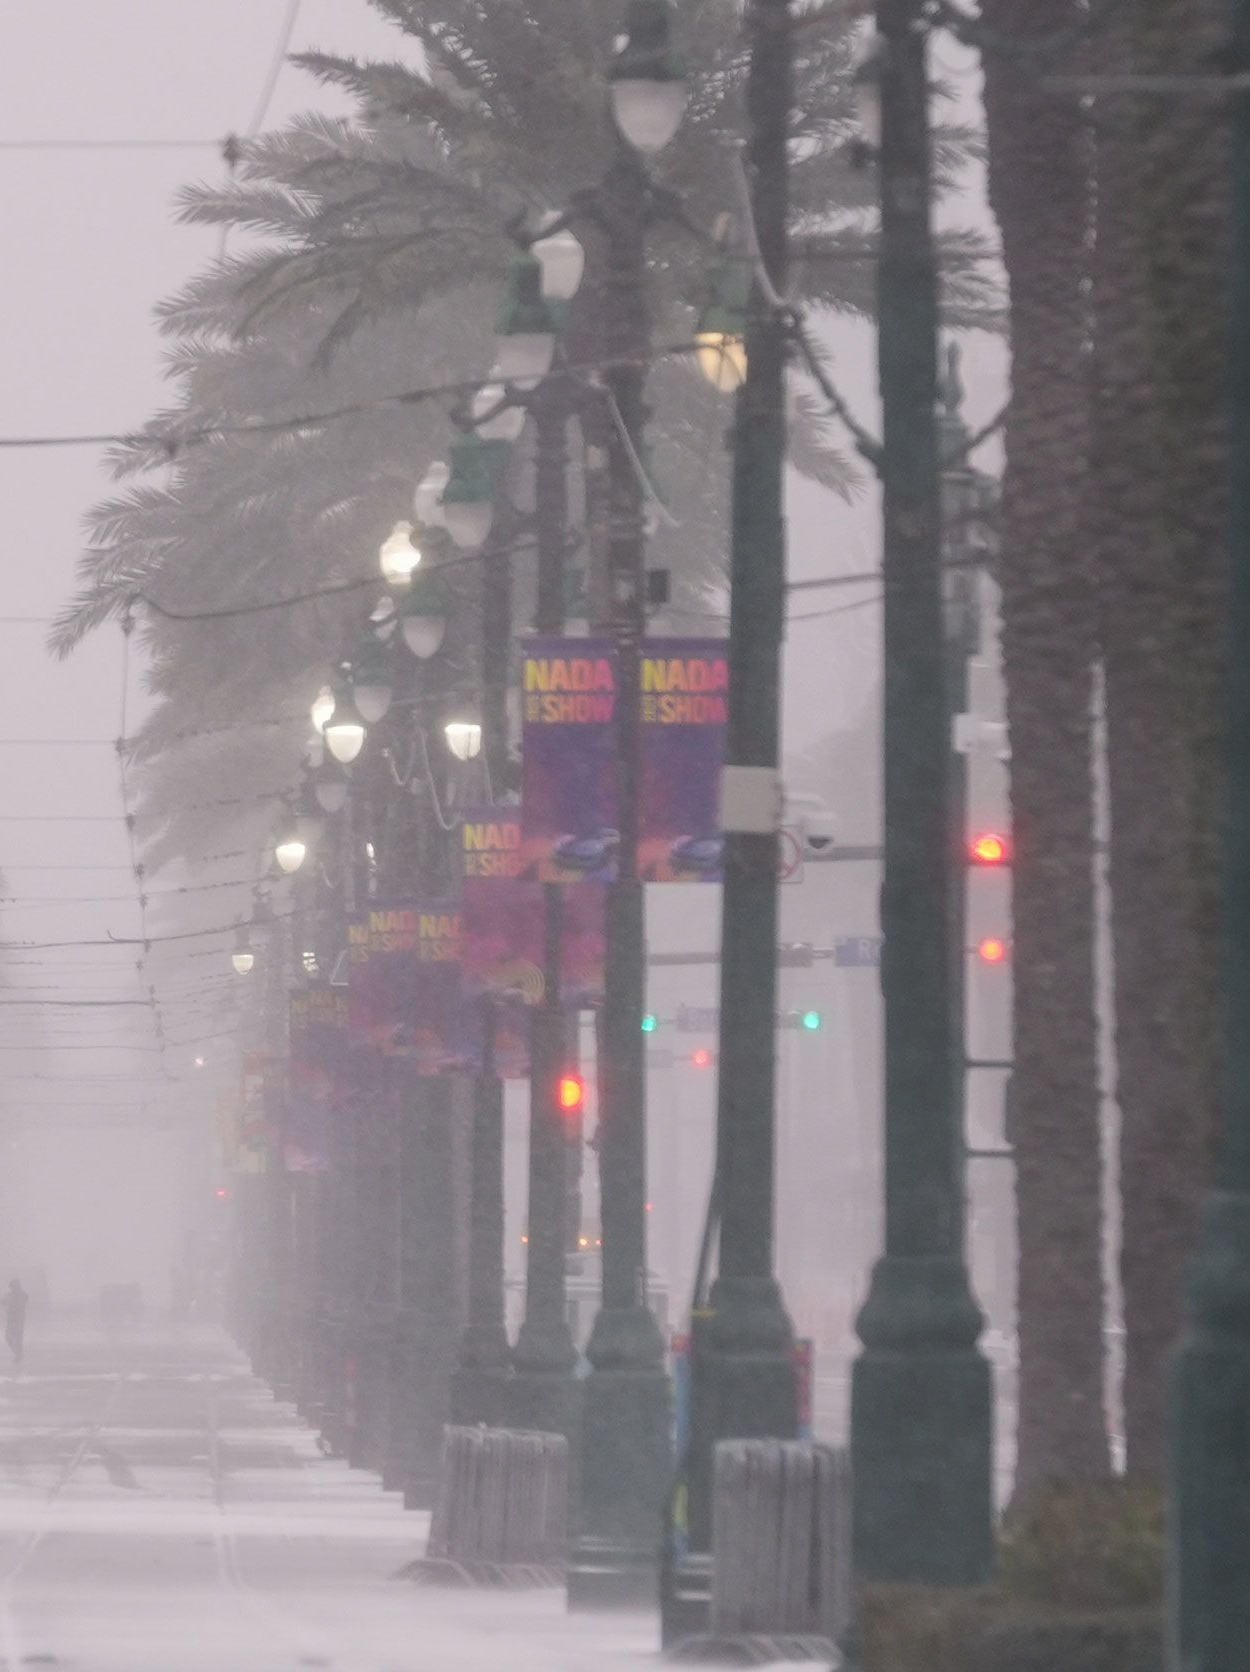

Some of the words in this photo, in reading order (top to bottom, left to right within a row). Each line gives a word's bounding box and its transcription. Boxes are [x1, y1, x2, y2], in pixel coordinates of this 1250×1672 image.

[525, 658, 615, 692] NADA
[640, 658, 728, 692] NADA
[540, 694, 615, 724] SHOW
[463, 822, 520, 851] NAD
